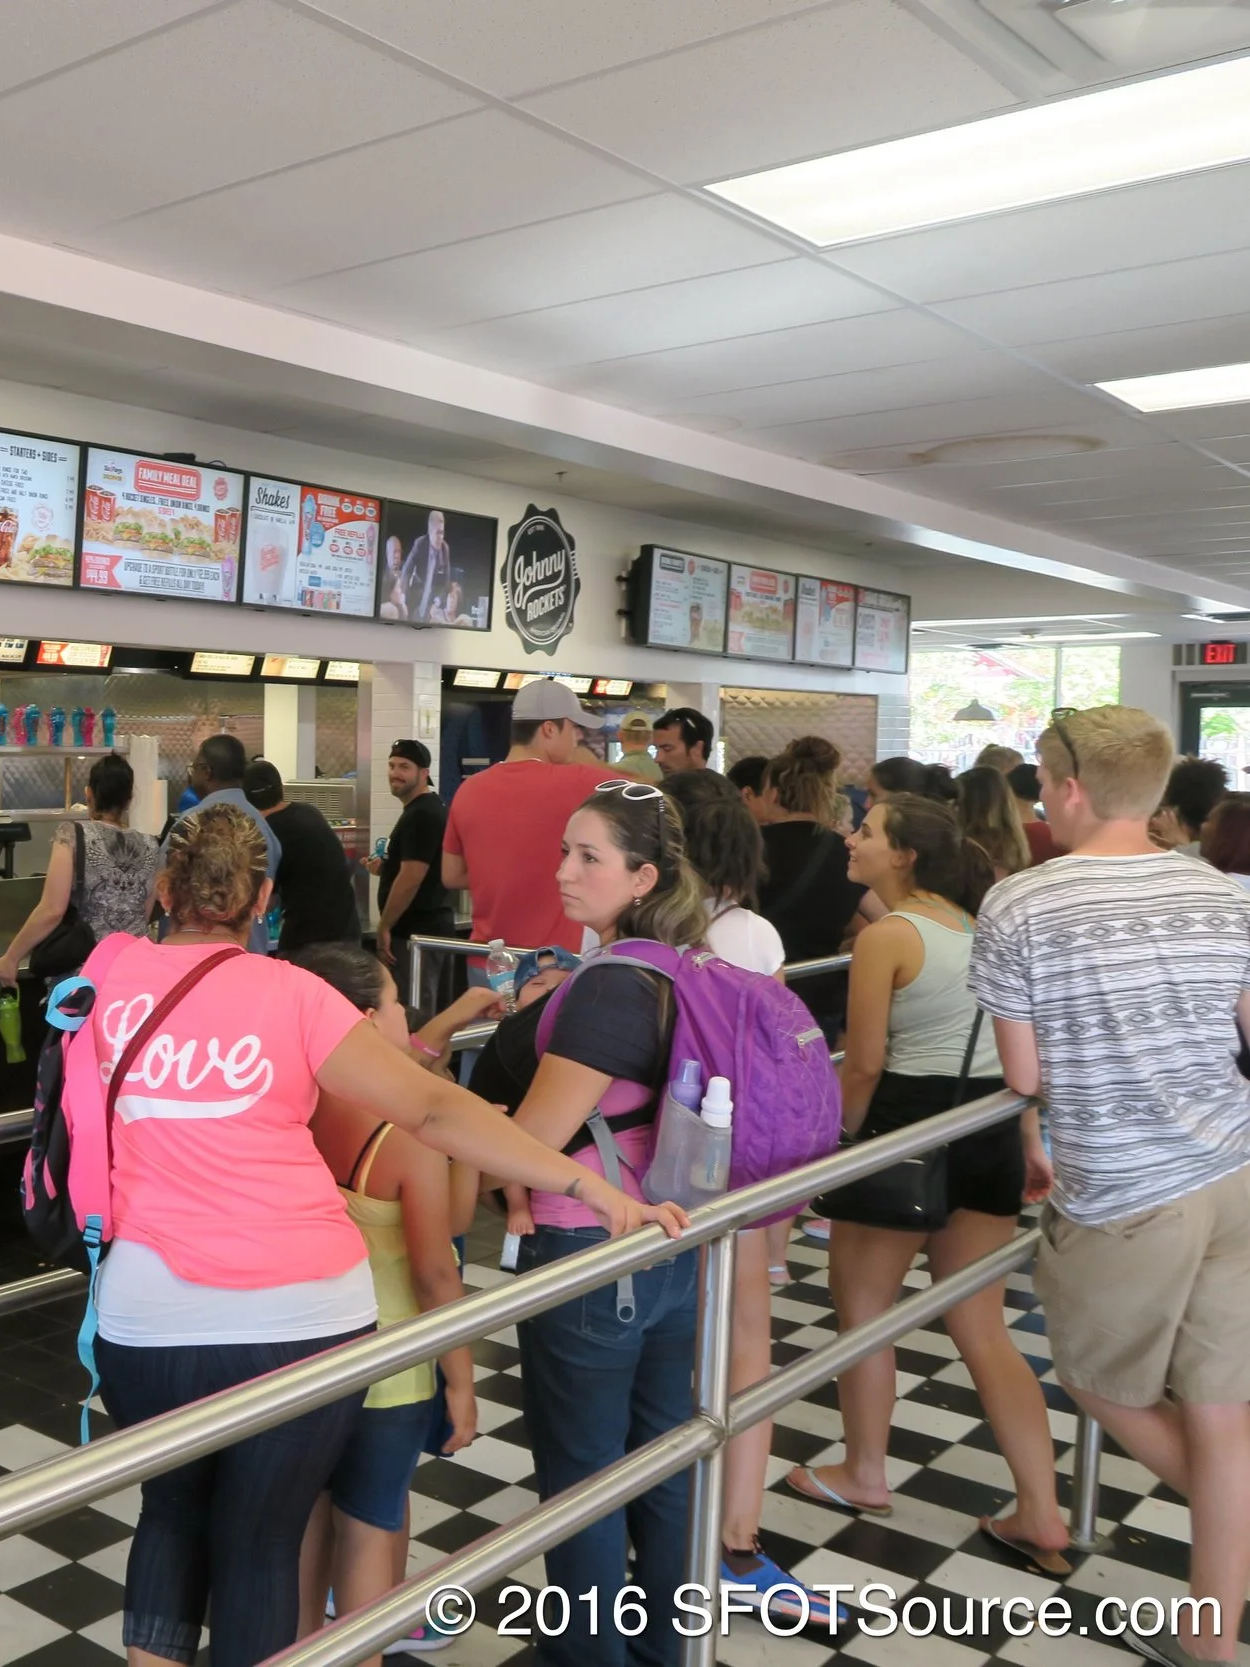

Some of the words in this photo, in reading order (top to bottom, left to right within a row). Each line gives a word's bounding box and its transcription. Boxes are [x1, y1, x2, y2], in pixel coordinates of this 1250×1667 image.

[10, 445, 36, 460] STARTERS
[42, 451, 57, 463] SIDES
[138, 467, 161, 481] FAMILY
[163, 471, 180, 484] MEAL
[182, 474, 197, 487] DEAL
[255, 487, 291, 509] Shakes
[514, 549, 565, 609] Johnny
[1205, 644, 1236, 664] EXIT
[100, 993, 270, 1090] Love
